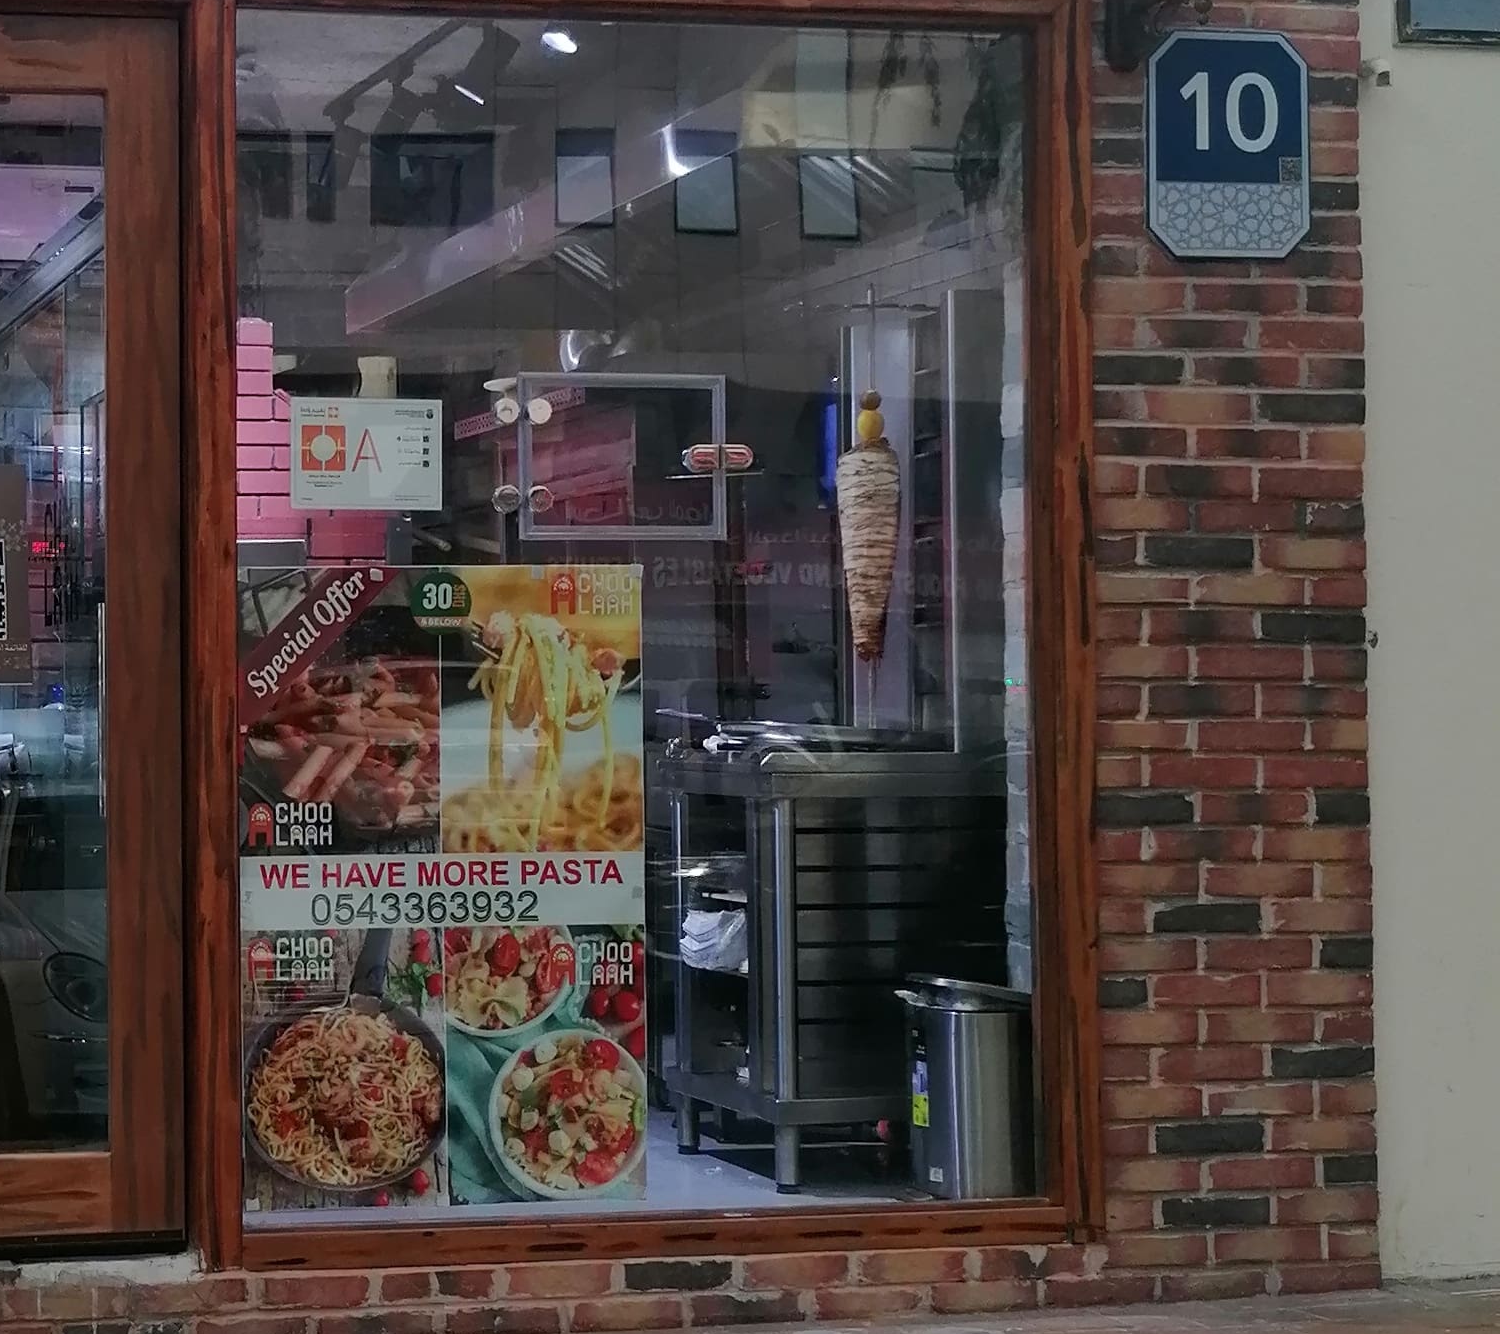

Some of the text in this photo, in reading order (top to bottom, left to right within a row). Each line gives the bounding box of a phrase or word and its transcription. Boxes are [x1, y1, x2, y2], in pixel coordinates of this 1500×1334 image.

[1179, 72, 1279, 153] 10
[351, 428, 382, 472] A
[422, 583, 453, 610] 30
[578, 593, 633, 617] LAAH
[246, 571, 365, 698] Special Offer
[275, 802, 333, 823] CHOO
[275, 824, 333, 846] LAAH
[260, 859, 624, 890] WE HAVE MORE PASTA
[311, 890, 540, 925] 0543363932
[275, 936, 334, 959] CHOO
[579, 941, 634, 964] CHOO
[275, 958, 334, 982] LAAH
[579, 963, 634, 985] LAAH
